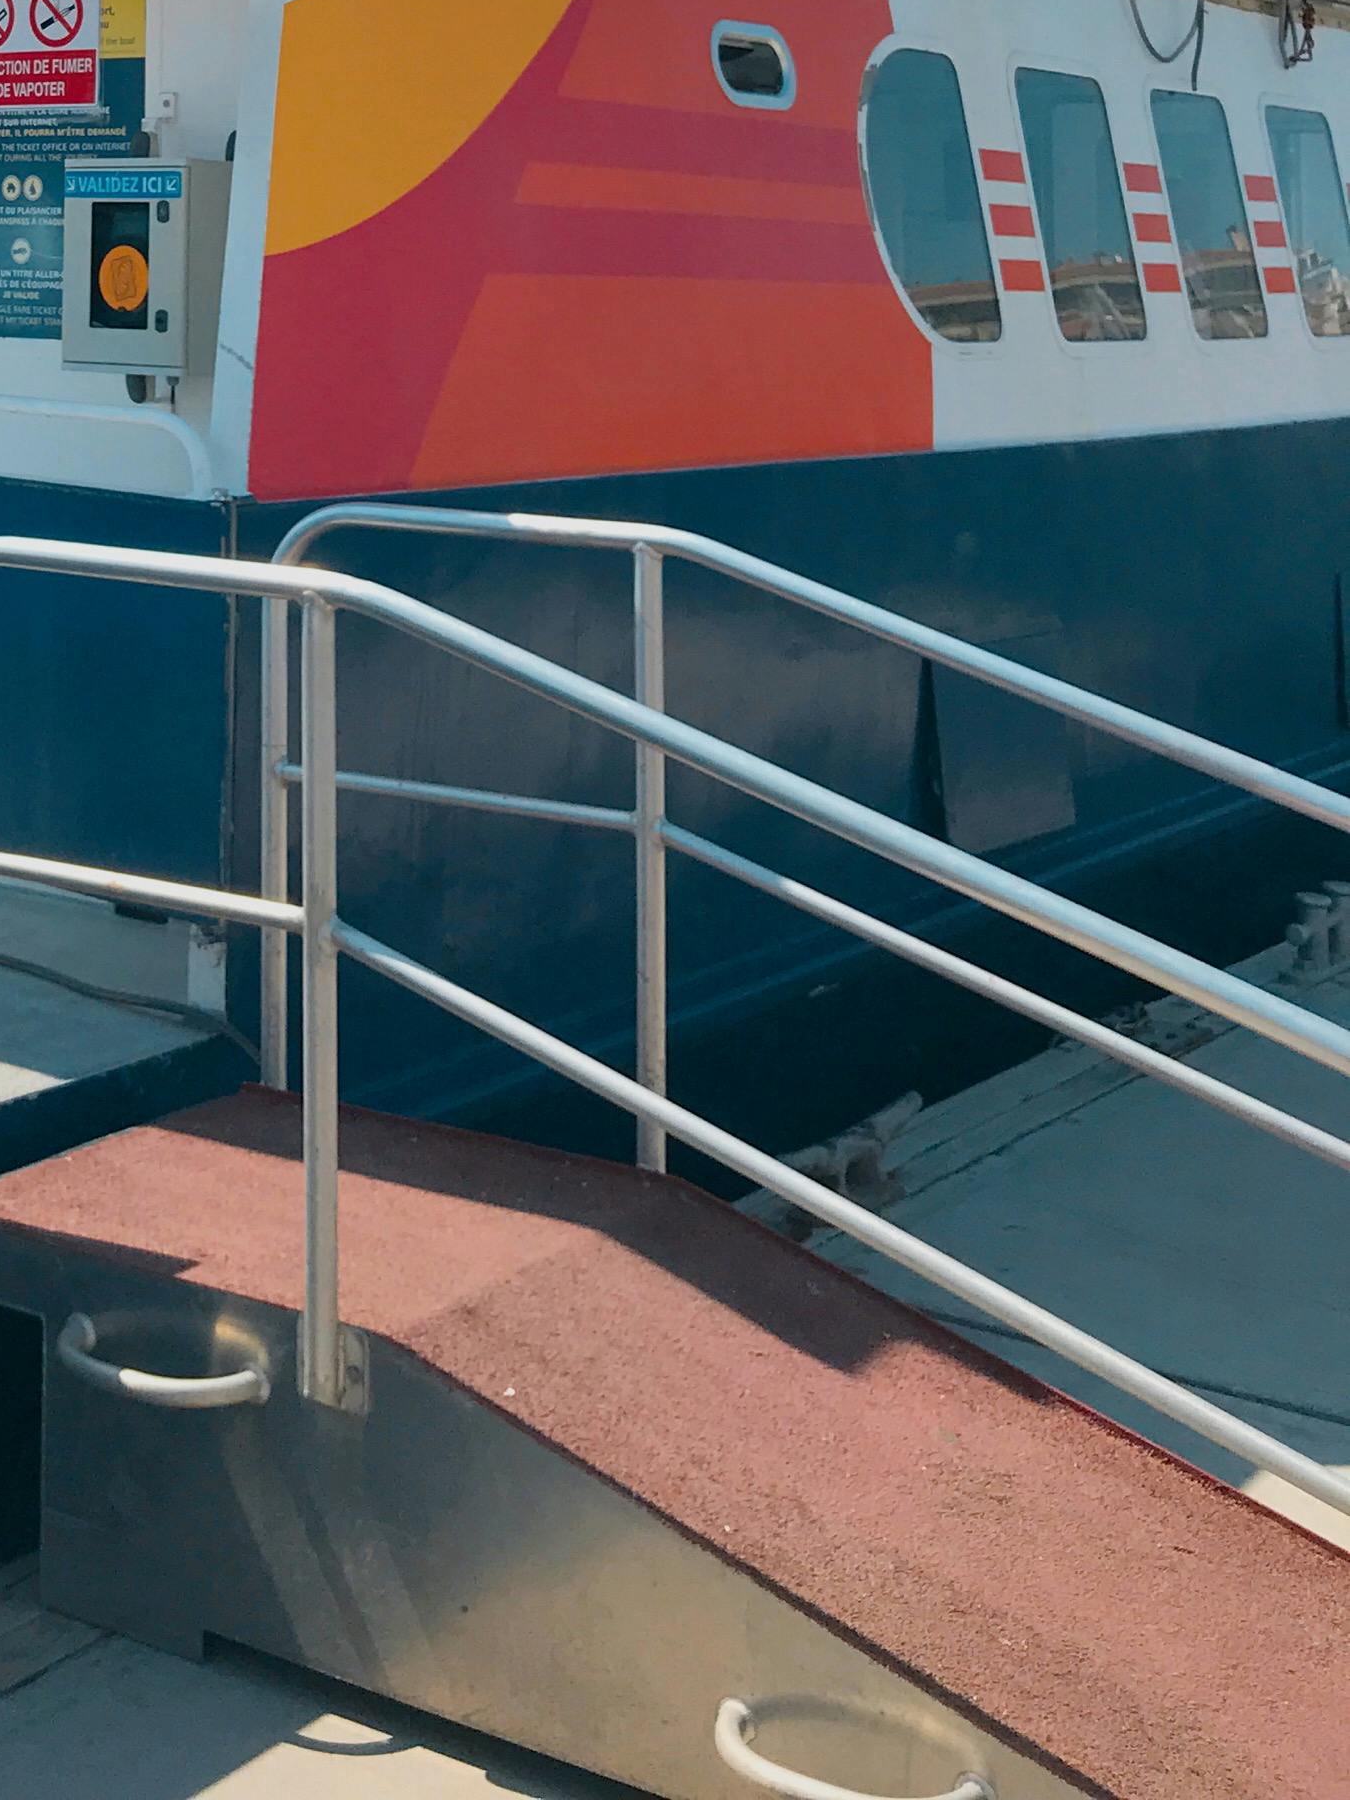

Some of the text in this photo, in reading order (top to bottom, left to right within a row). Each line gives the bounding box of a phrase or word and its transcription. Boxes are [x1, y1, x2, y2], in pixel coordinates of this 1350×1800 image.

[33, 59, 50, 75] DE
[52, 57, 93, 74] FUMER
[13, 81, 66, 98] VAPOTER
[23, 128, 55, 137] POURRA
[1, 143, 15, 152] THE
[16, 143, 40, 152] TICKET
[41, 142, 68, 151] OFFICE
[94, 141, 131, 151] INTERNET
[78, 175, 162, 193] VALIDEZ ICI
